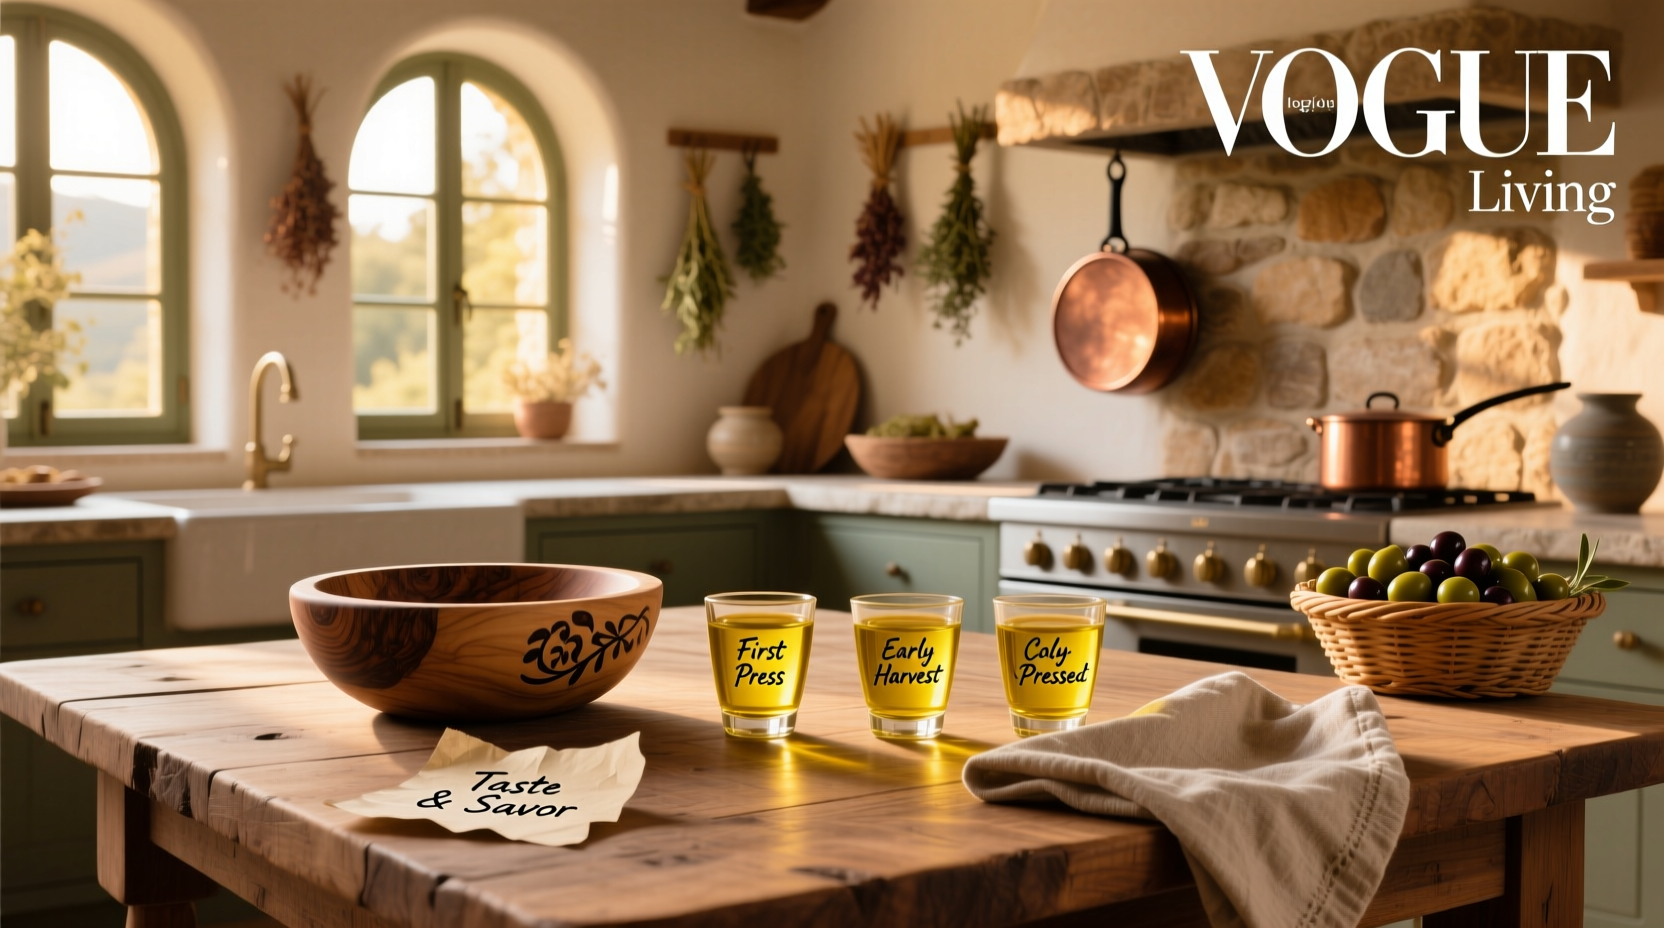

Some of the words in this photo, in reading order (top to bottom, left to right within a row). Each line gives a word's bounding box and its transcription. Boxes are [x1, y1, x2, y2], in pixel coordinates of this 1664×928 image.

[736, 636, 787, 661] First
[881, 636, 934, 668] Early
[734, 662, 786, 688] Press
[873, 664, 944, 687] Harvest
[1018, 662, 1090, 687] Pressed
[471, 770, 561, 795] Taste
[416, 789, 453, 810] &
[463, 794, 578, 818] Savor
